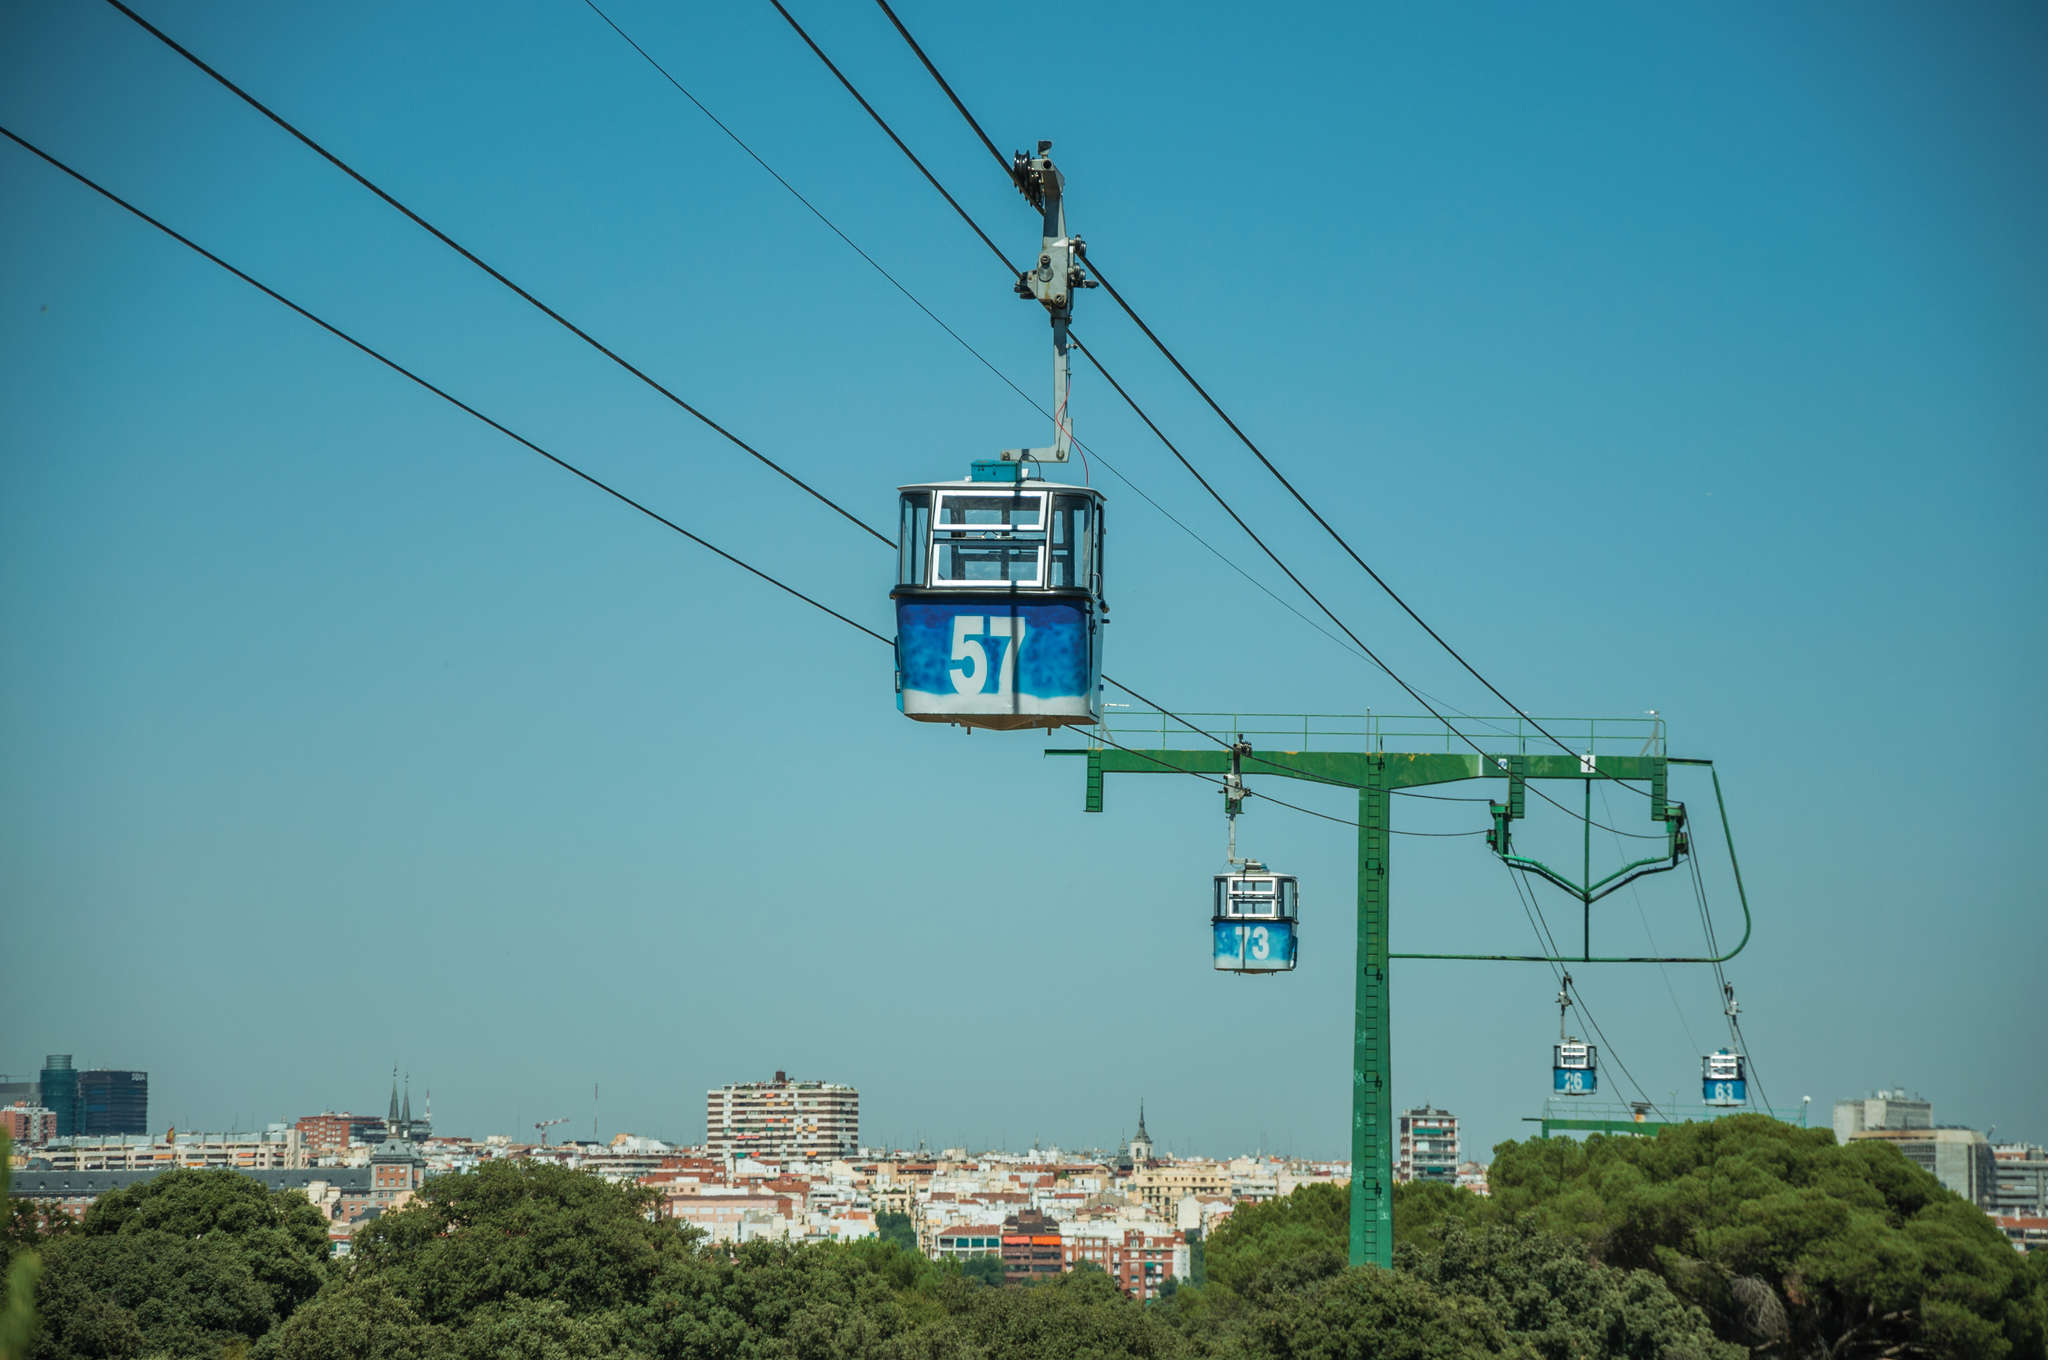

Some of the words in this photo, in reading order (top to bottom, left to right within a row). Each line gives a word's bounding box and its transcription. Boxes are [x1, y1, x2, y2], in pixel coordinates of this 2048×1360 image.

[949, 615, 1026, 697] 57
[1235, 926, 1270, 960] 73
[1564, 1072, 1583, 1089] 26
[1715, 1083, 1733, 1099] 63
